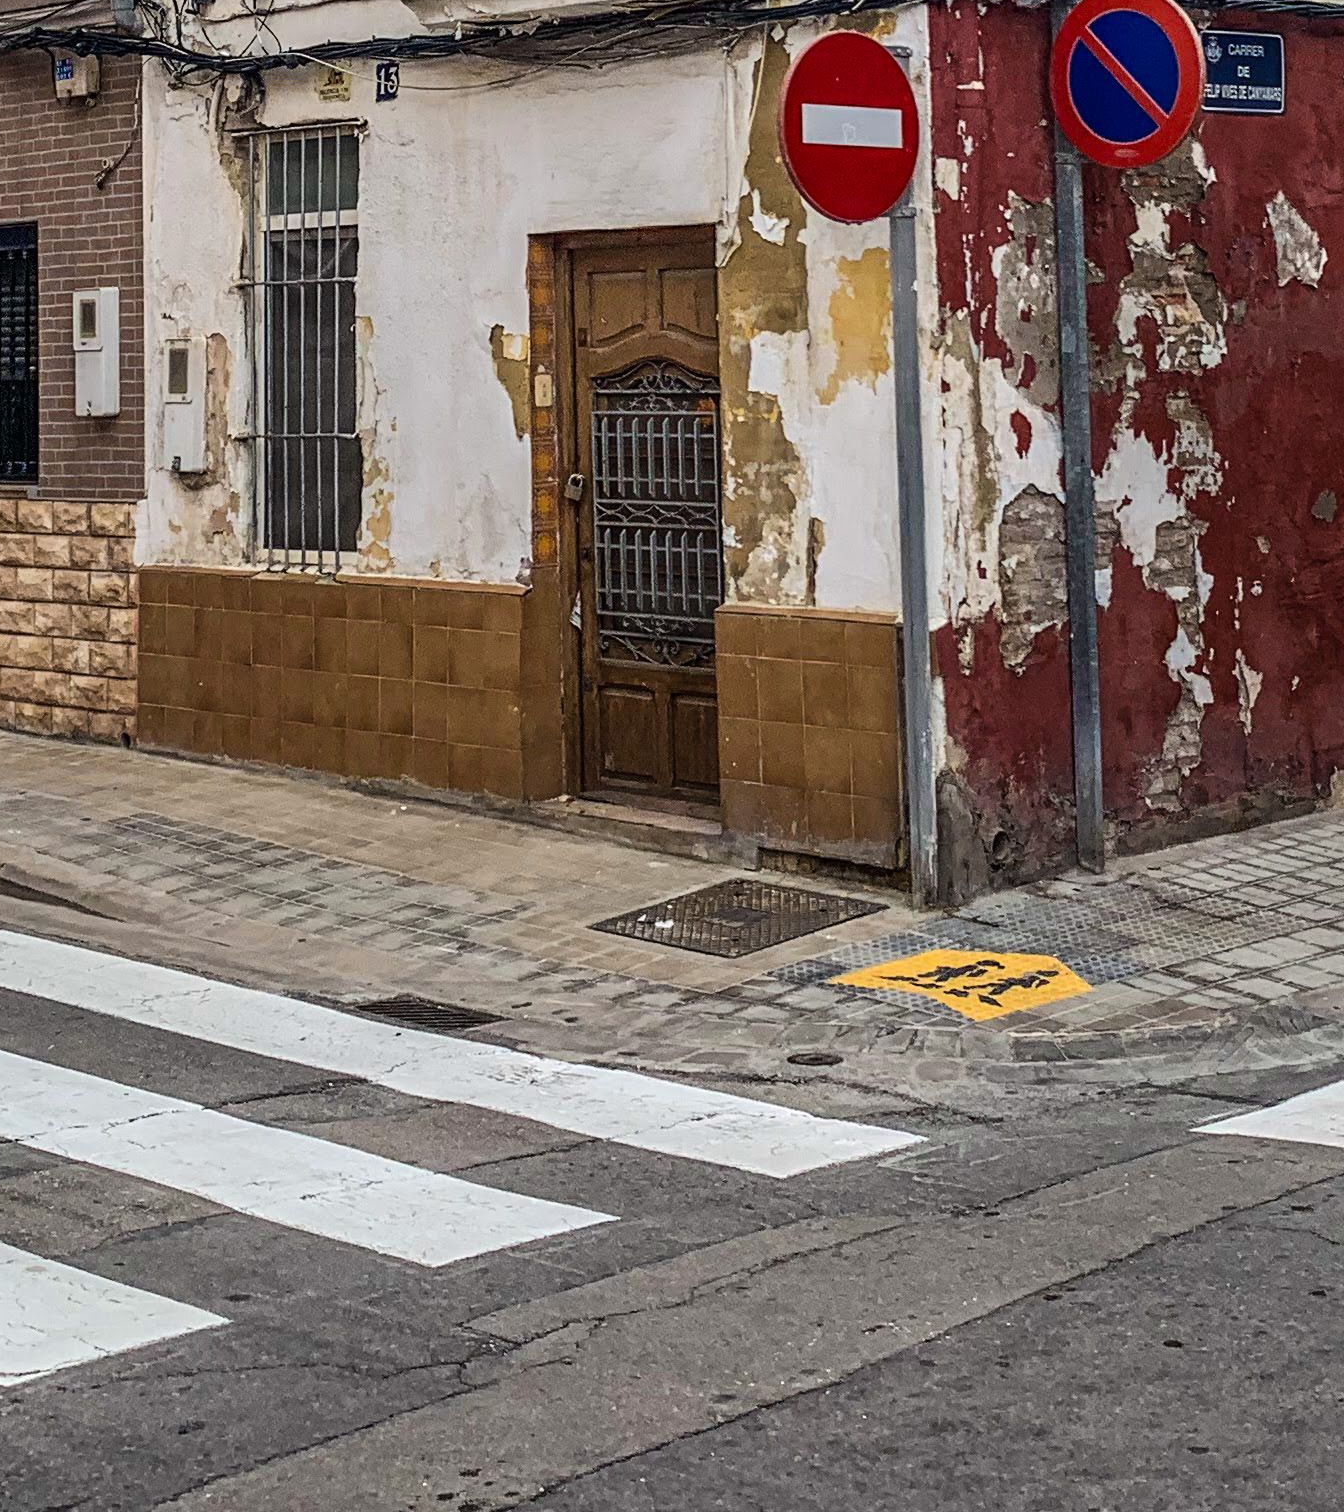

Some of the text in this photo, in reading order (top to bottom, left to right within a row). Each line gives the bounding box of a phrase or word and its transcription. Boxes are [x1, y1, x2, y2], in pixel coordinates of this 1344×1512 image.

[1228, 43, 1264, 57] CARRER
[1237, 65, 1250, 78] DE
[378, 65, 398, 96] 13
[1238, 85, 1248, 99] DE
